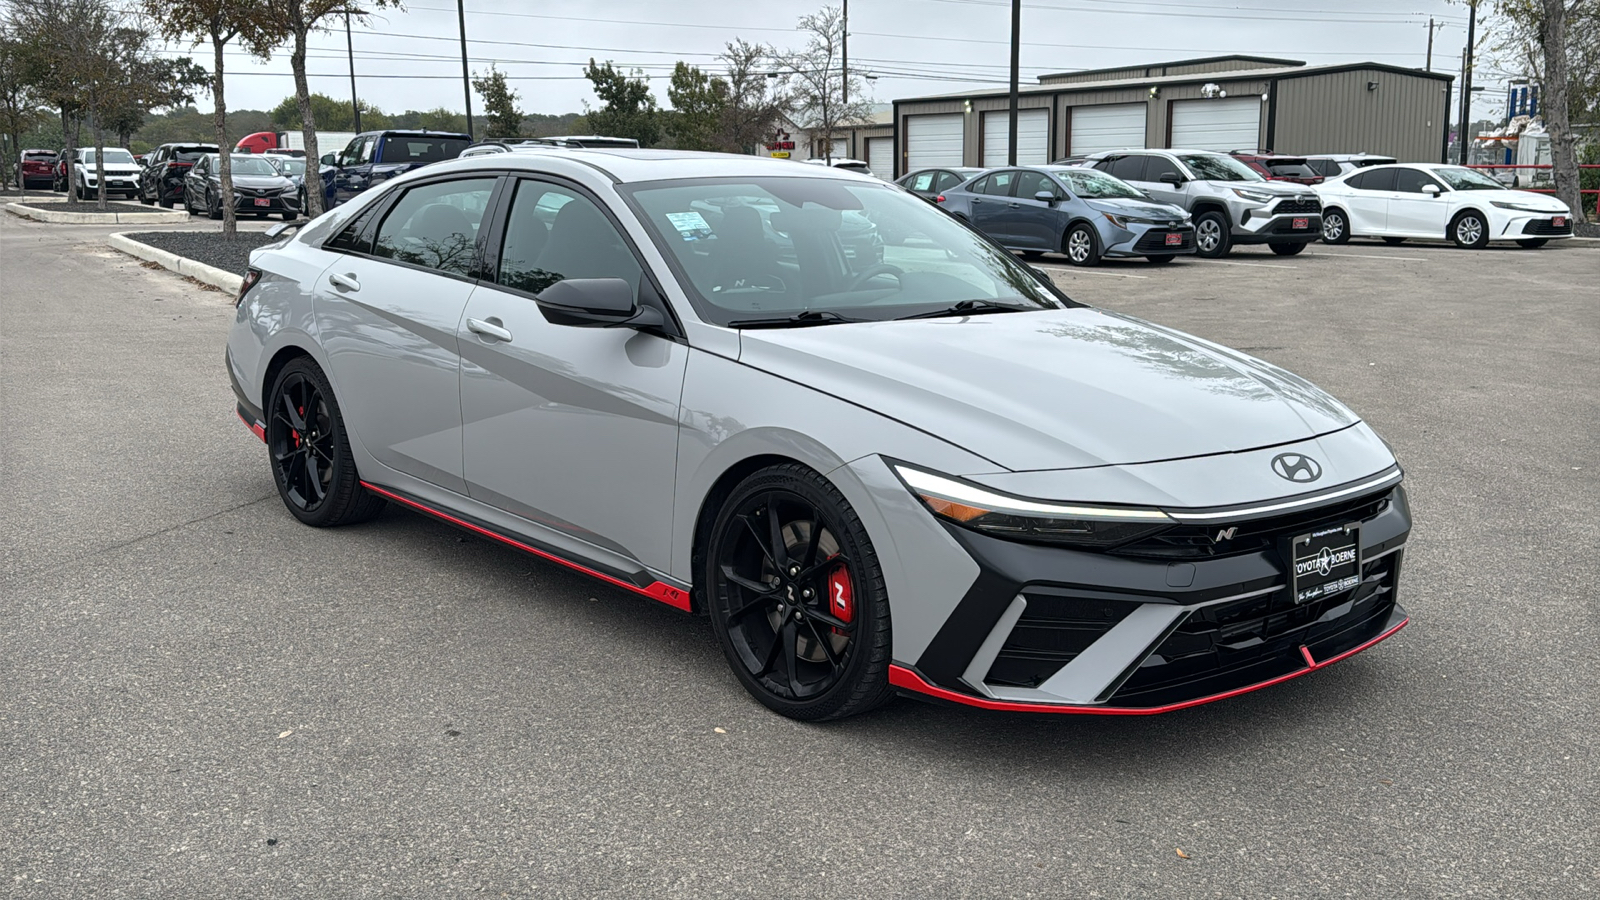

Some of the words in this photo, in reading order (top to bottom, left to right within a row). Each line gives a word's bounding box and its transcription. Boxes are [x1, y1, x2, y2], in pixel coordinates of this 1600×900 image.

[735, 279, 745, 287] N
[1215, 526, 1238, 542] N
[1331, 548, 1356, 564] BOERNE
[834, 581, 846, 611] N
